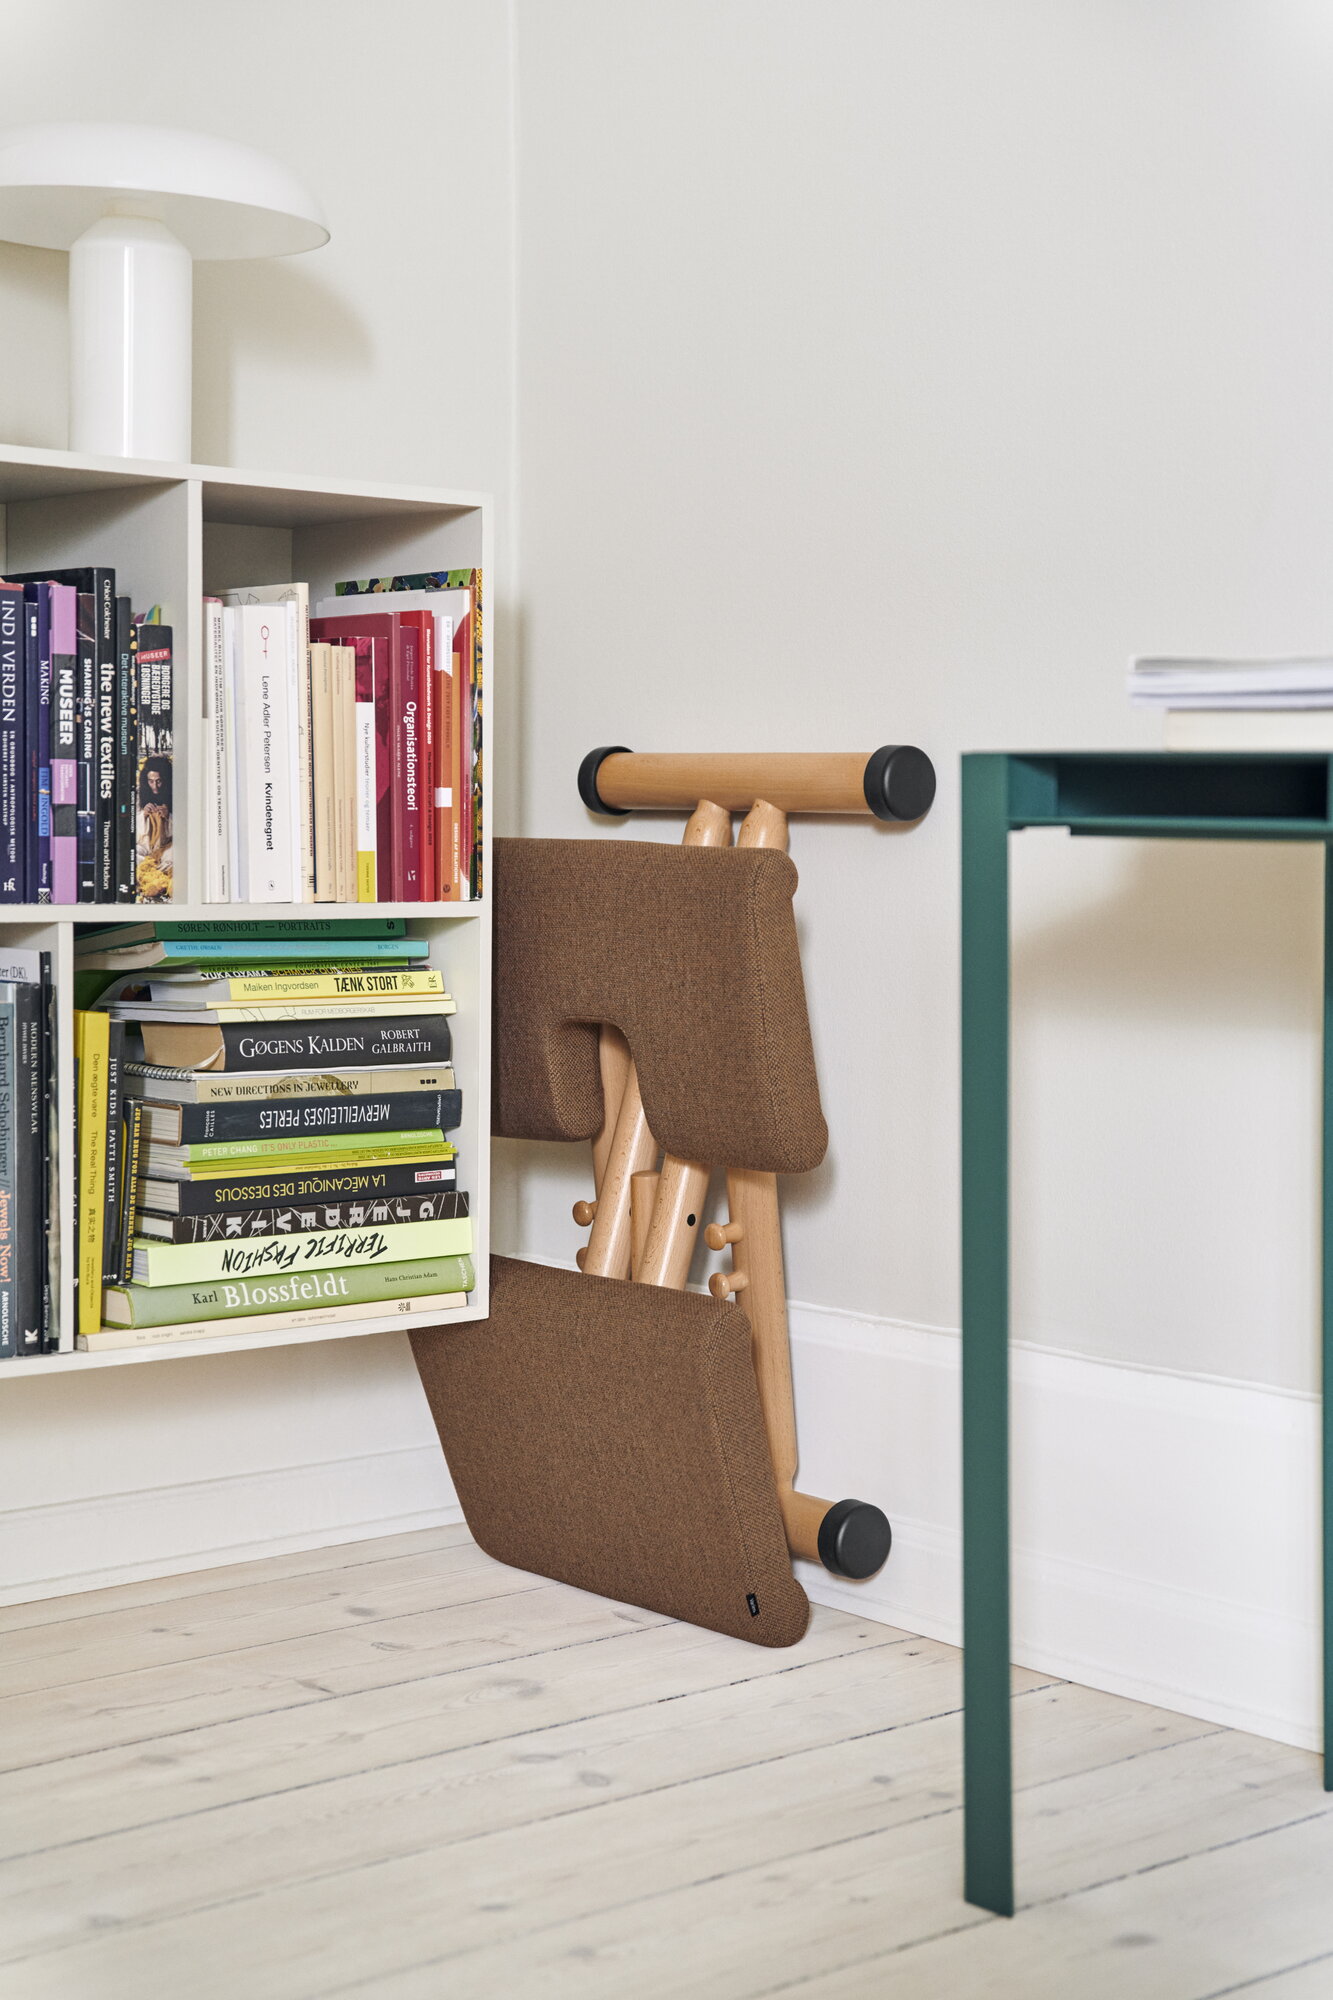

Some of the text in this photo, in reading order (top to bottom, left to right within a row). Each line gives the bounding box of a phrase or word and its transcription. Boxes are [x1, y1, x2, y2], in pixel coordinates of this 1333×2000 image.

[2, 600, 16, 636] IND
[103, 602, 112, 640] Colchester
[121, 654, 129, 669] Det
[2, 650, 16, 722] VERDEN
[40, 660, 50, 706] MAKING
[84, 658, 92, 702] SHARING
[122, 670, 130, 714] interaktive
[152, 664, 160, 715] BÆREDYGTIGE
[162, 664, 170, 710] BORGERE OG
[59, 669, 74, 746] MUSEER
[262, 675, 272, 774] Lene Adler Petersen
[84, 719, 92, 759] CARING
[100, 663, 115, 799] the new textiles
[403, 701, 418, 811] Organisationsteori
[41, 797, 50, 836] INGOLD
[264, 782, 274, 850] Kvindetegnet
[178, 920, 332, 933] SØREN RØNHOLT PORTRAITS
[202, 970, 268, 980] YUKA OYAMA
[243, 979, 319, 993] Maiken Ingvordsen
[272, 966, 363, 976] SCHMUCK QUIKIES
[334, 976, 398, 992] TÆNK STORT
[0, 1016, 10, 1087] Bernhard
[239, 1036, 364, 1058] GØGENS KALDEN
[372, 1042, 432, 1055] GALBRAITH
[380, 1028, 420, 1041] ROBERT
[110, 1058, 118, 1084] JUST
[210, 1080, 360, 1098] NEW DIRECTIONS IN JEWELLERY
[260, 1103, 391, 1129] MERVEILLEUSES PERLES
[108, 1129, 116, 1162] PATTI
[202, 1142, 297, 1158] PETER CHANG IT'S ONLY
[88, 1171, 96, 1195] Thing
[215, 1186, 270, 1202] DESSOUS
[273, 1183, 294, 1197] DES
[372, 1175, 386, 1187] LA
[0, 1190, 12, 1283] Jewels Now!
[222, 1233, 388, 1274] TERRIFIC FASHION
[192, 1273, 350, 1308] Karl Blossfeldt
[1, 1290, 9, 1346] ARNOLDSCHE
